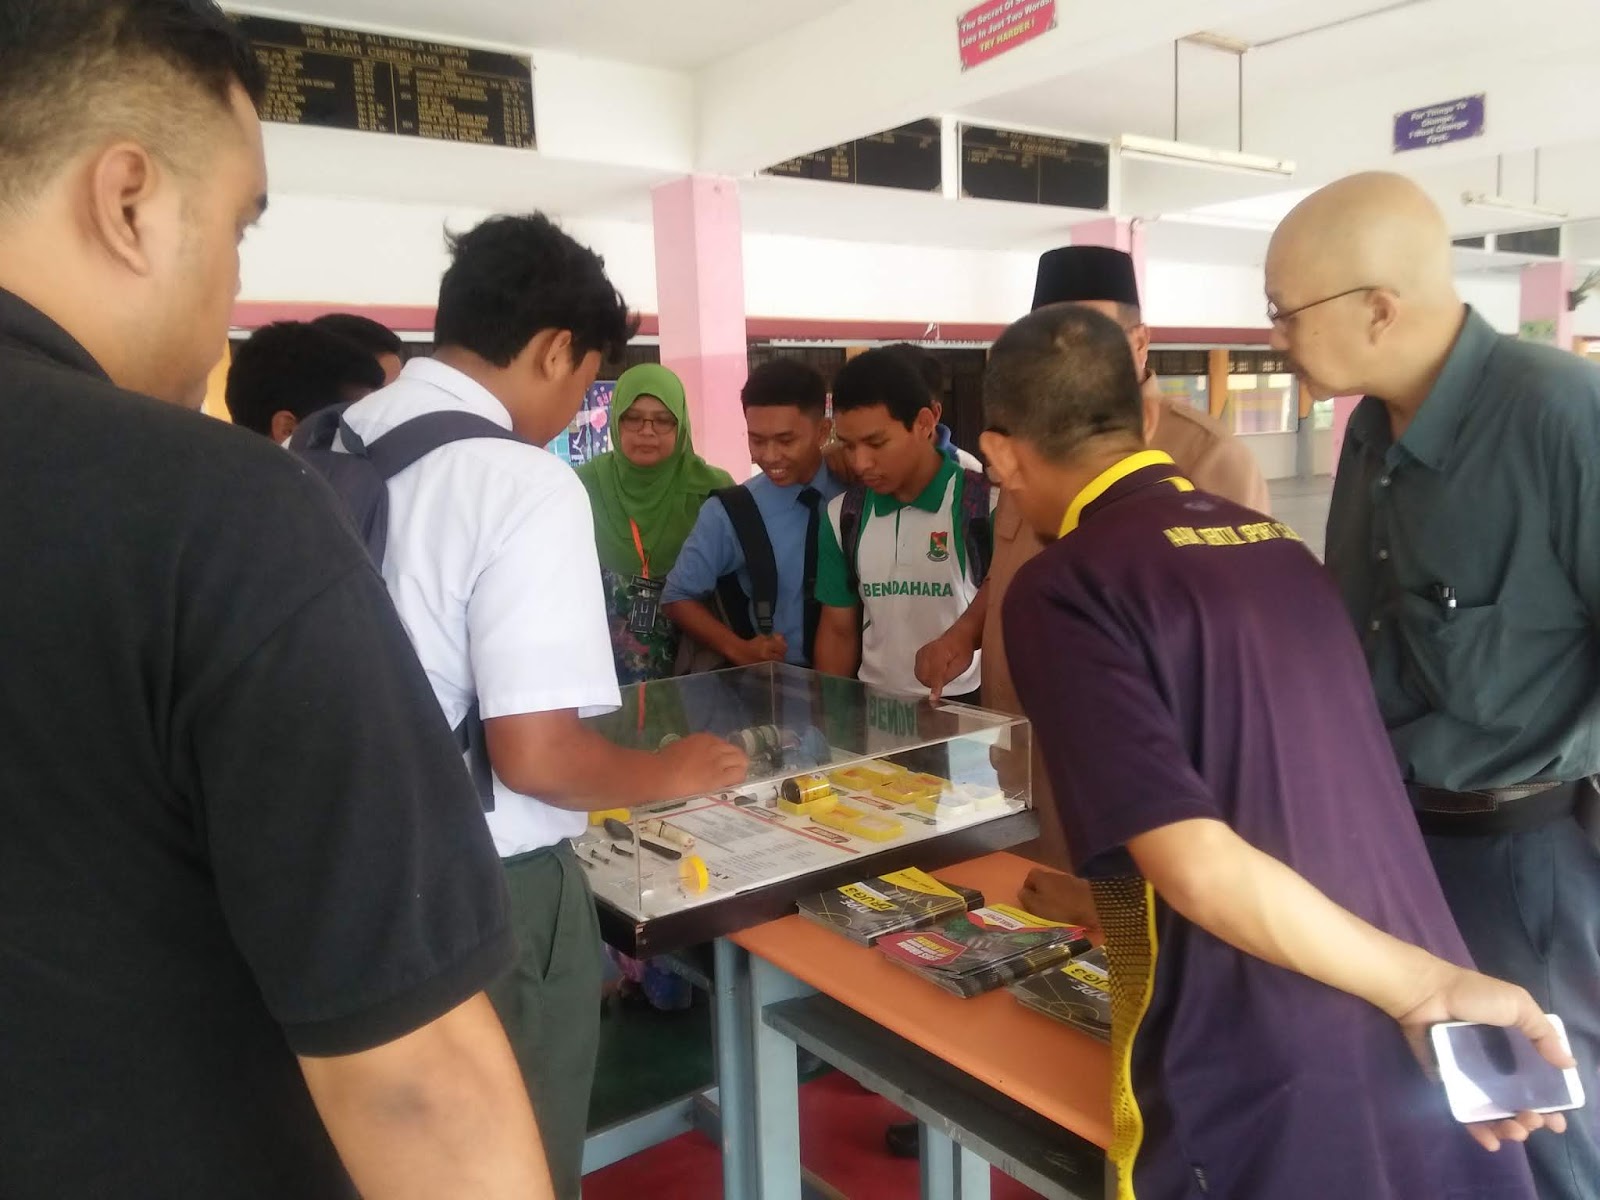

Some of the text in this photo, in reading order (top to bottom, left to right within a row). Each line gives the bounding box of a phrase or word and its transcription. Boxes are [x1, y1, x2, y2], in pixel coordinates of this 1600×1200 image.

[961, 20, 976, 33] The
[977, 5, 1003, 26] Secret
[961, 34, 977, 48] Lies
[978, 28, 987, 40] In
[988, 19, 1005, 36] Just
[1006, 11, 1023, 25] Two
[979, 38, 995, 52] TRY
[863, 581, 953, 597] BENDAHARA
[844, 887, 893, 910] DRUGS
